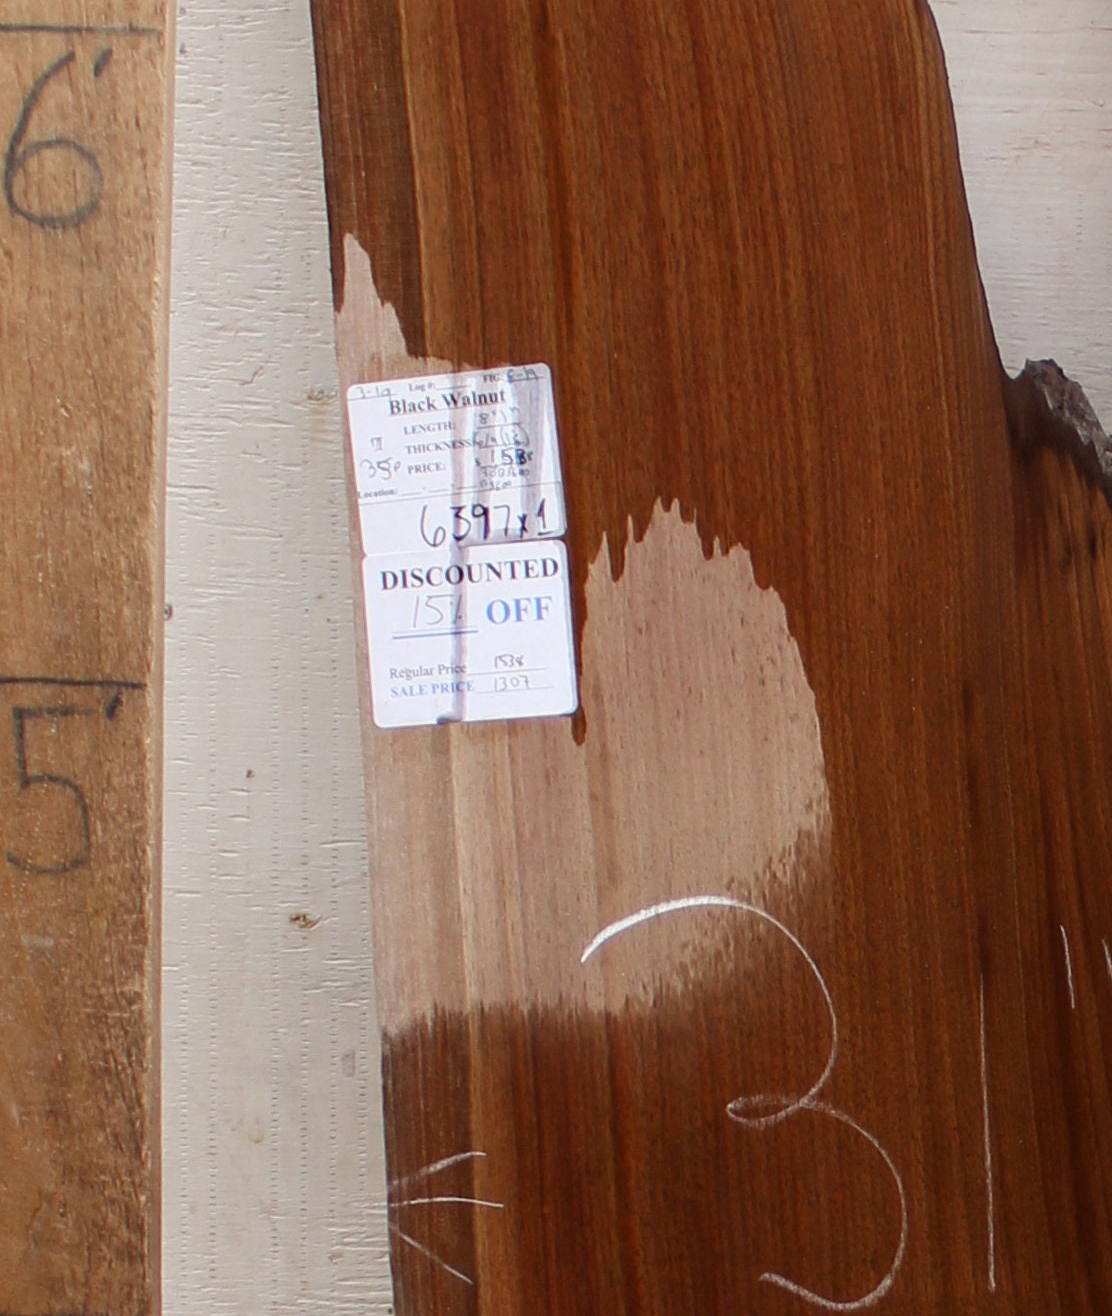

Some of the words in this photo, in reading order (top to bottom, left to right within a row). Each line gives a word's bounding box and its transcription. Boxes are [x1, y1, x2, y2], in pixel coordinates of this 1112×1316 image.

[388, 396, 438, 416] Black
[442, 389, 505, 411] Walnut
[379, 557, 559, 591] DISCOUNTED
[486, 595, 553, 625] OFF
[389, 666, 434, 681] Regular
[438, 663, 467, 677] Price
[390, 681, 428, 698] SALE
[432, 679, 475, 695] PRICE
